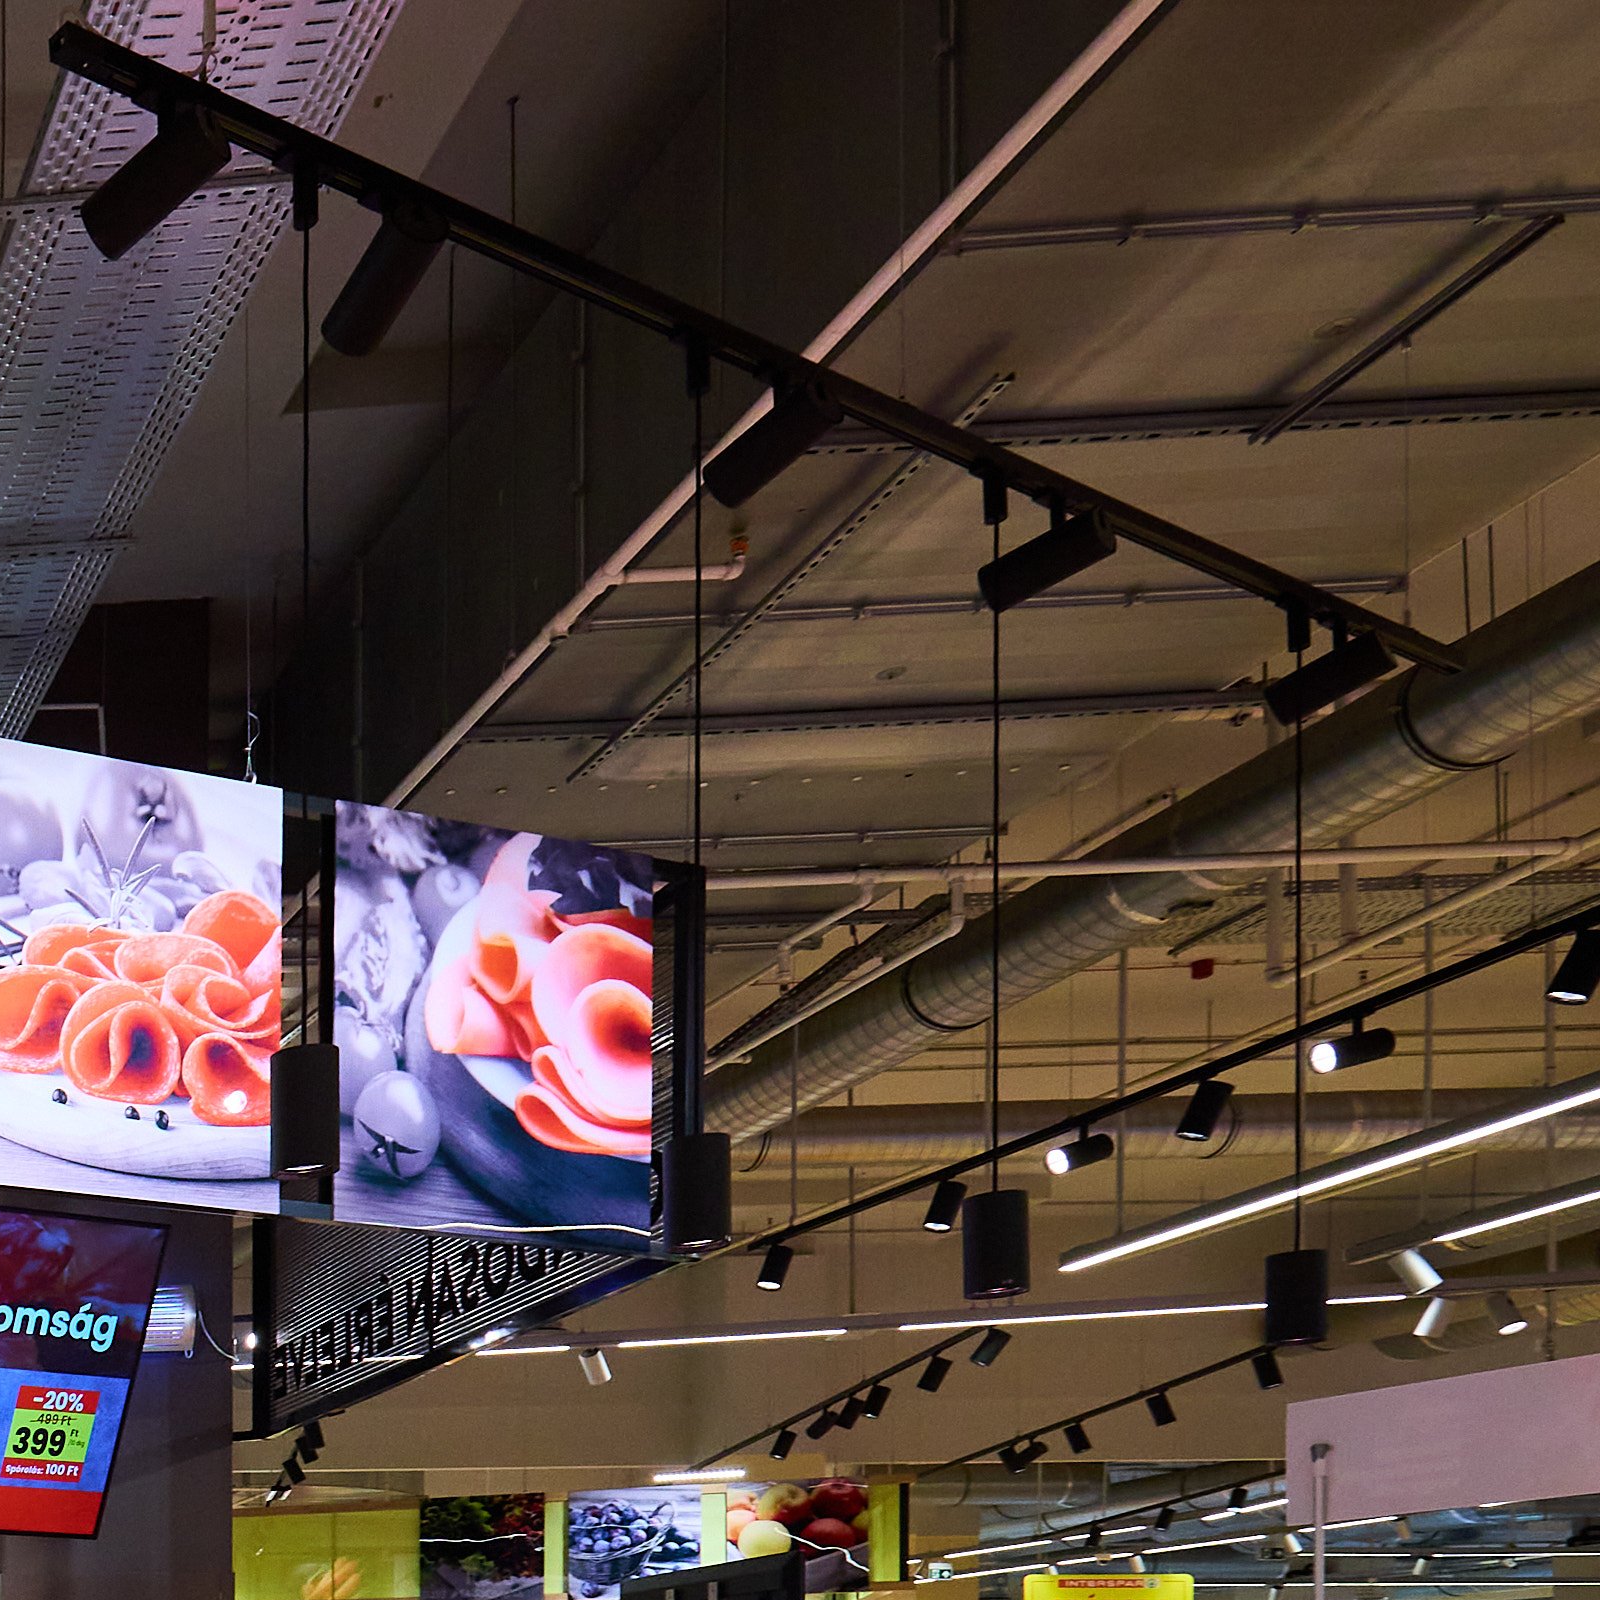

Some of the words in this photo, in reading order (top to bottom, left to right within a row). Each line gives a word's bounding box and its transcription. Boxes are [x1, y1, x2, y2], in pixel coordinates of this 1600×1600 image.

[33, 1391, 84, 1412] -20%
[12, 1427, 66, 1457] 399
[46, 1464, 64, 1476] 100
[66, 1465, 79, 1477] Ft
[1065, 1580, 1144, 1588] INTERSPAR
